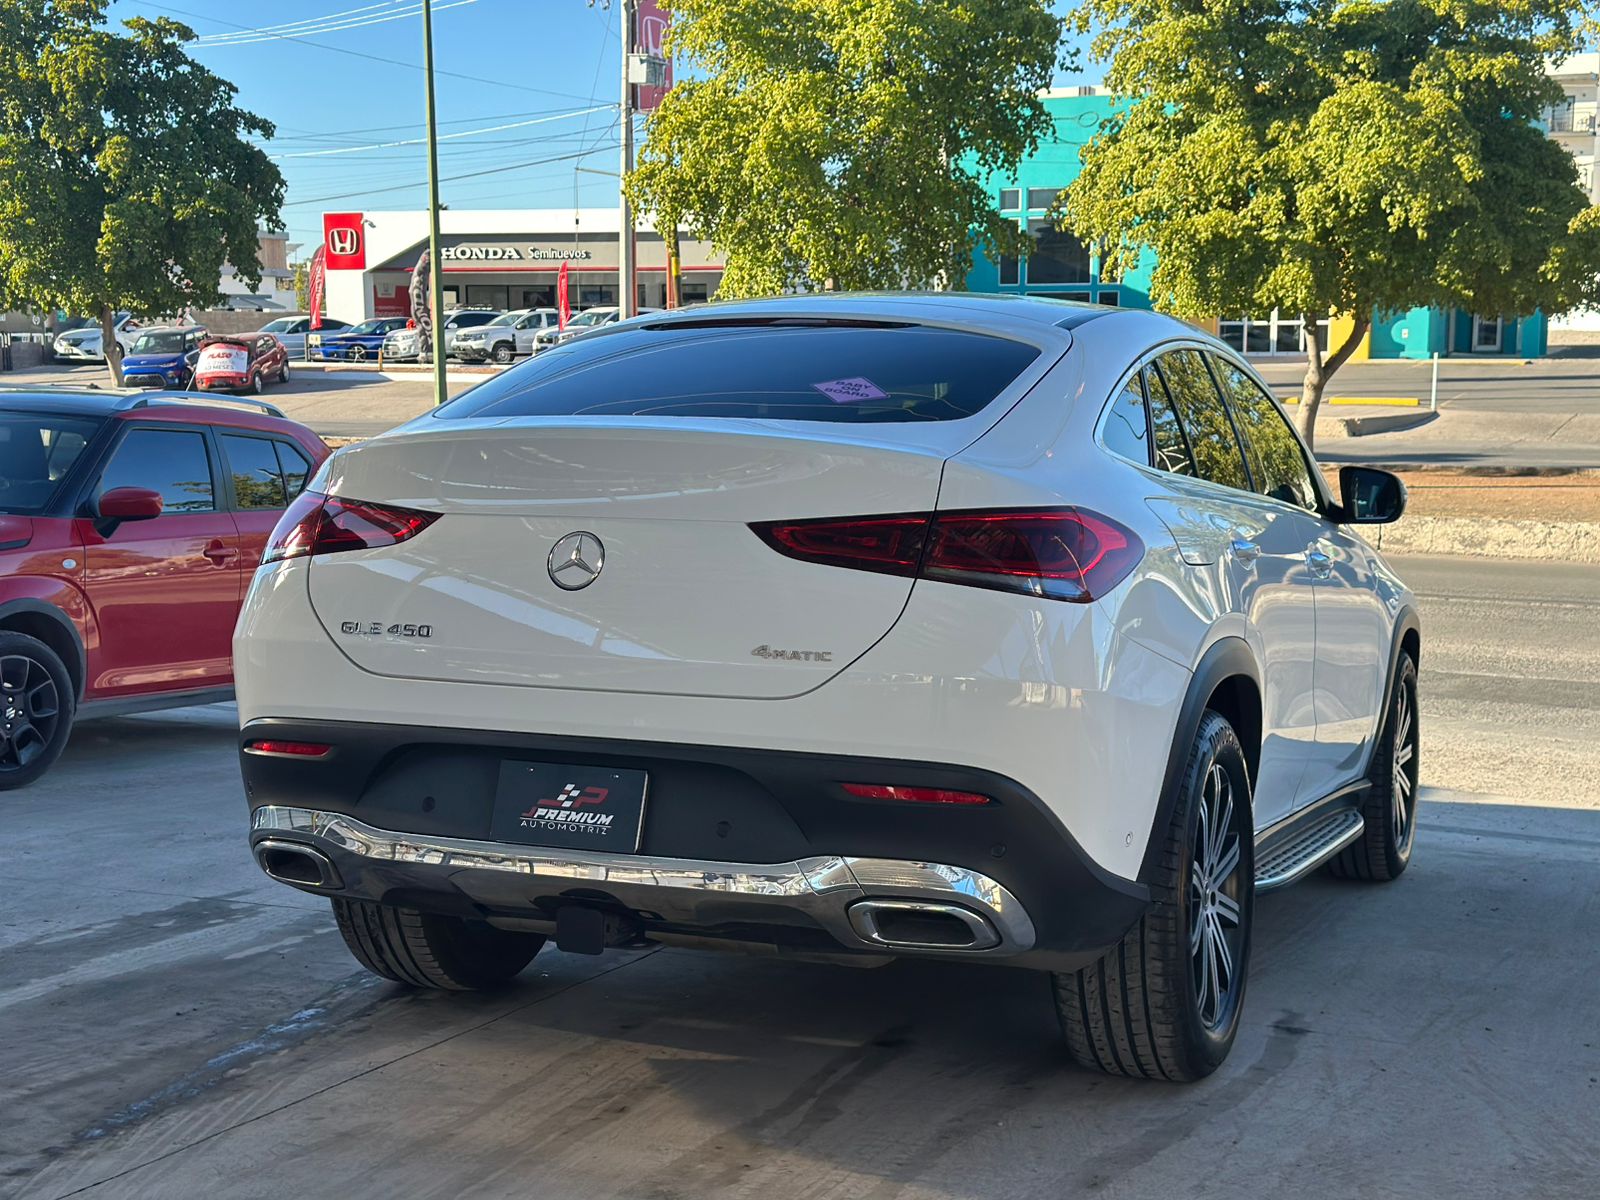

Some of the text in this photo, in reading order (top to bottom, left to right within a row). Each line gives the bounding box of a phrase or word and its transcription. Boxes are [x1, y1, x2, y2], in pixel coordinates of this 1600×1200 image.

[441, 246, 588, 260] HONDA Seminuevos
[824, 387, 870, 398] BOARD
[341, 621, 432, 637] GLE 450
[751, 644, 832, 662] 4MATIC
[533, 807, 614, 825] PREMIUM
[520, 820, 608, 835] AUTOMOTRIZ
